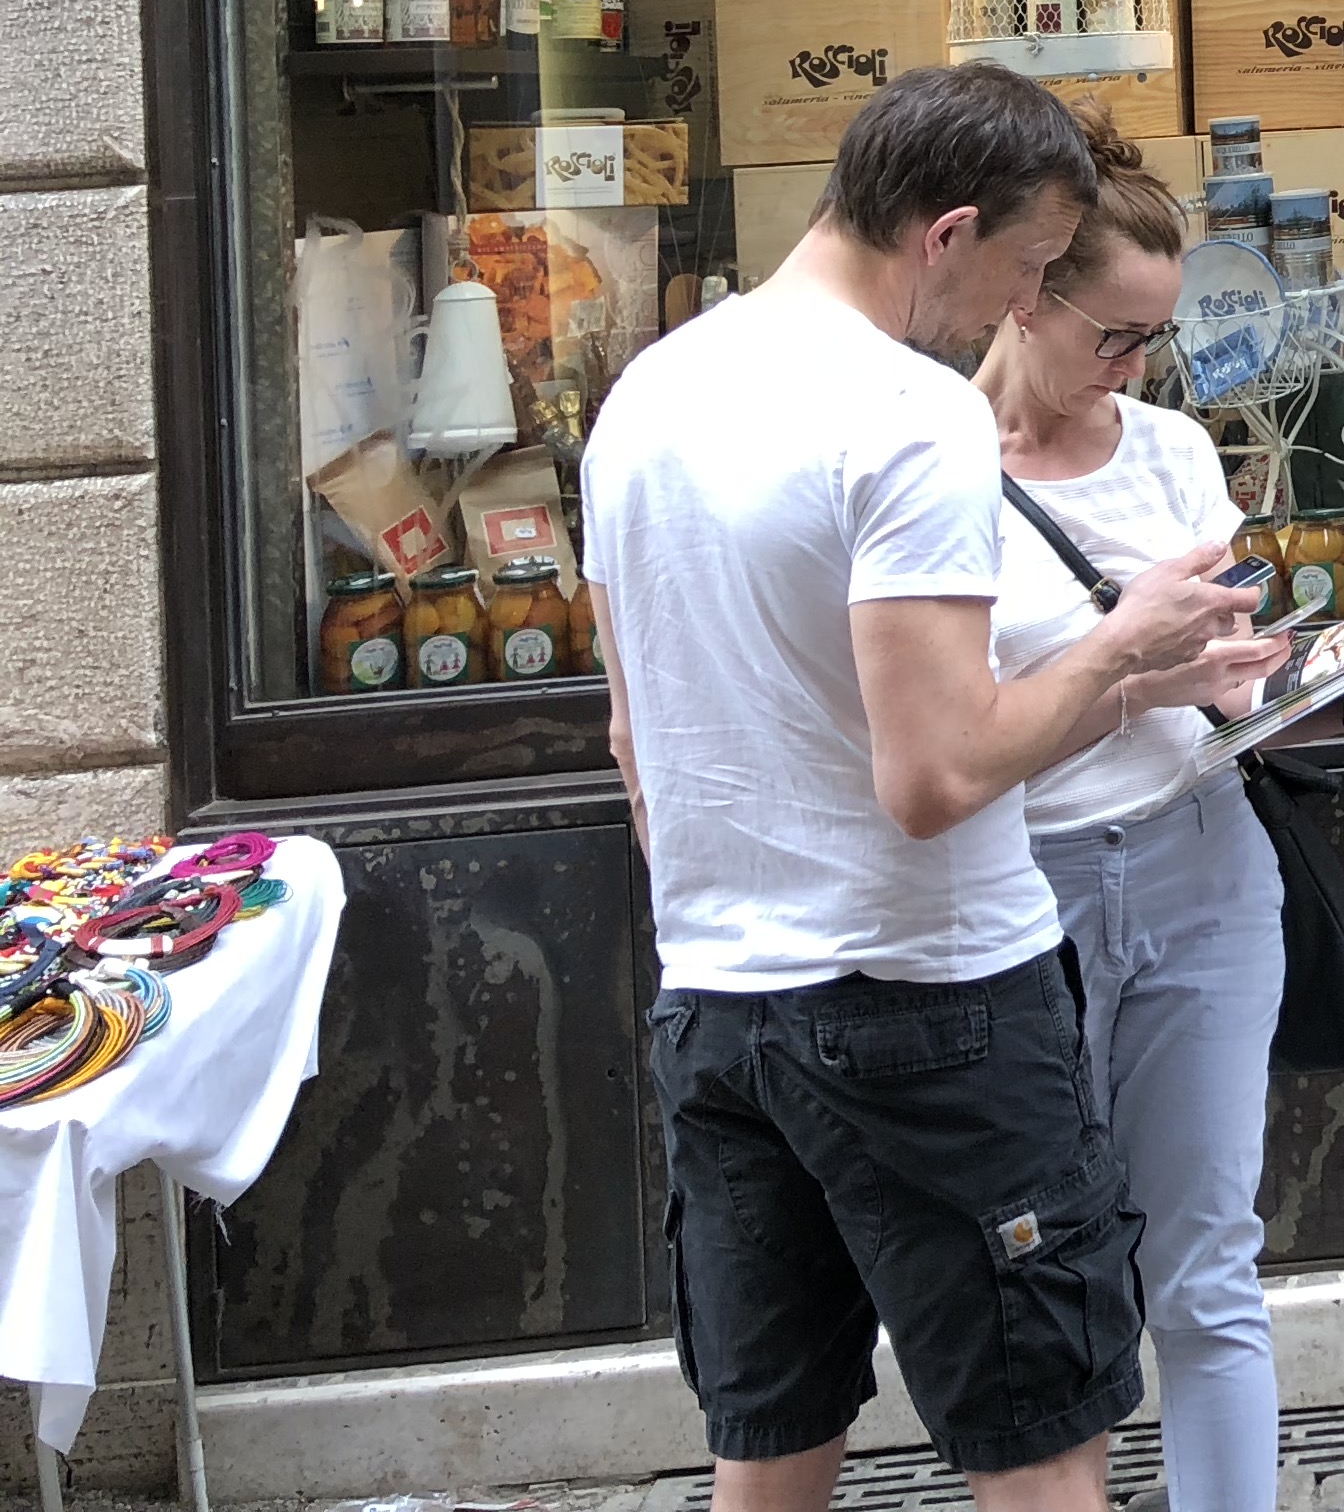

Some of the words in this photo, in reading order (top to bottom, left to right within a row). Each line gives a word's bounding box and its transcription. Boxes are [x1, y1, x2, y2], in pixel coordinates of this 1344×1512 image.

[788, 44, 889, 89] Roscioli
[1236, 63, 1302, 76] salumeria
[544, 152, 617, 183] Roscioli
